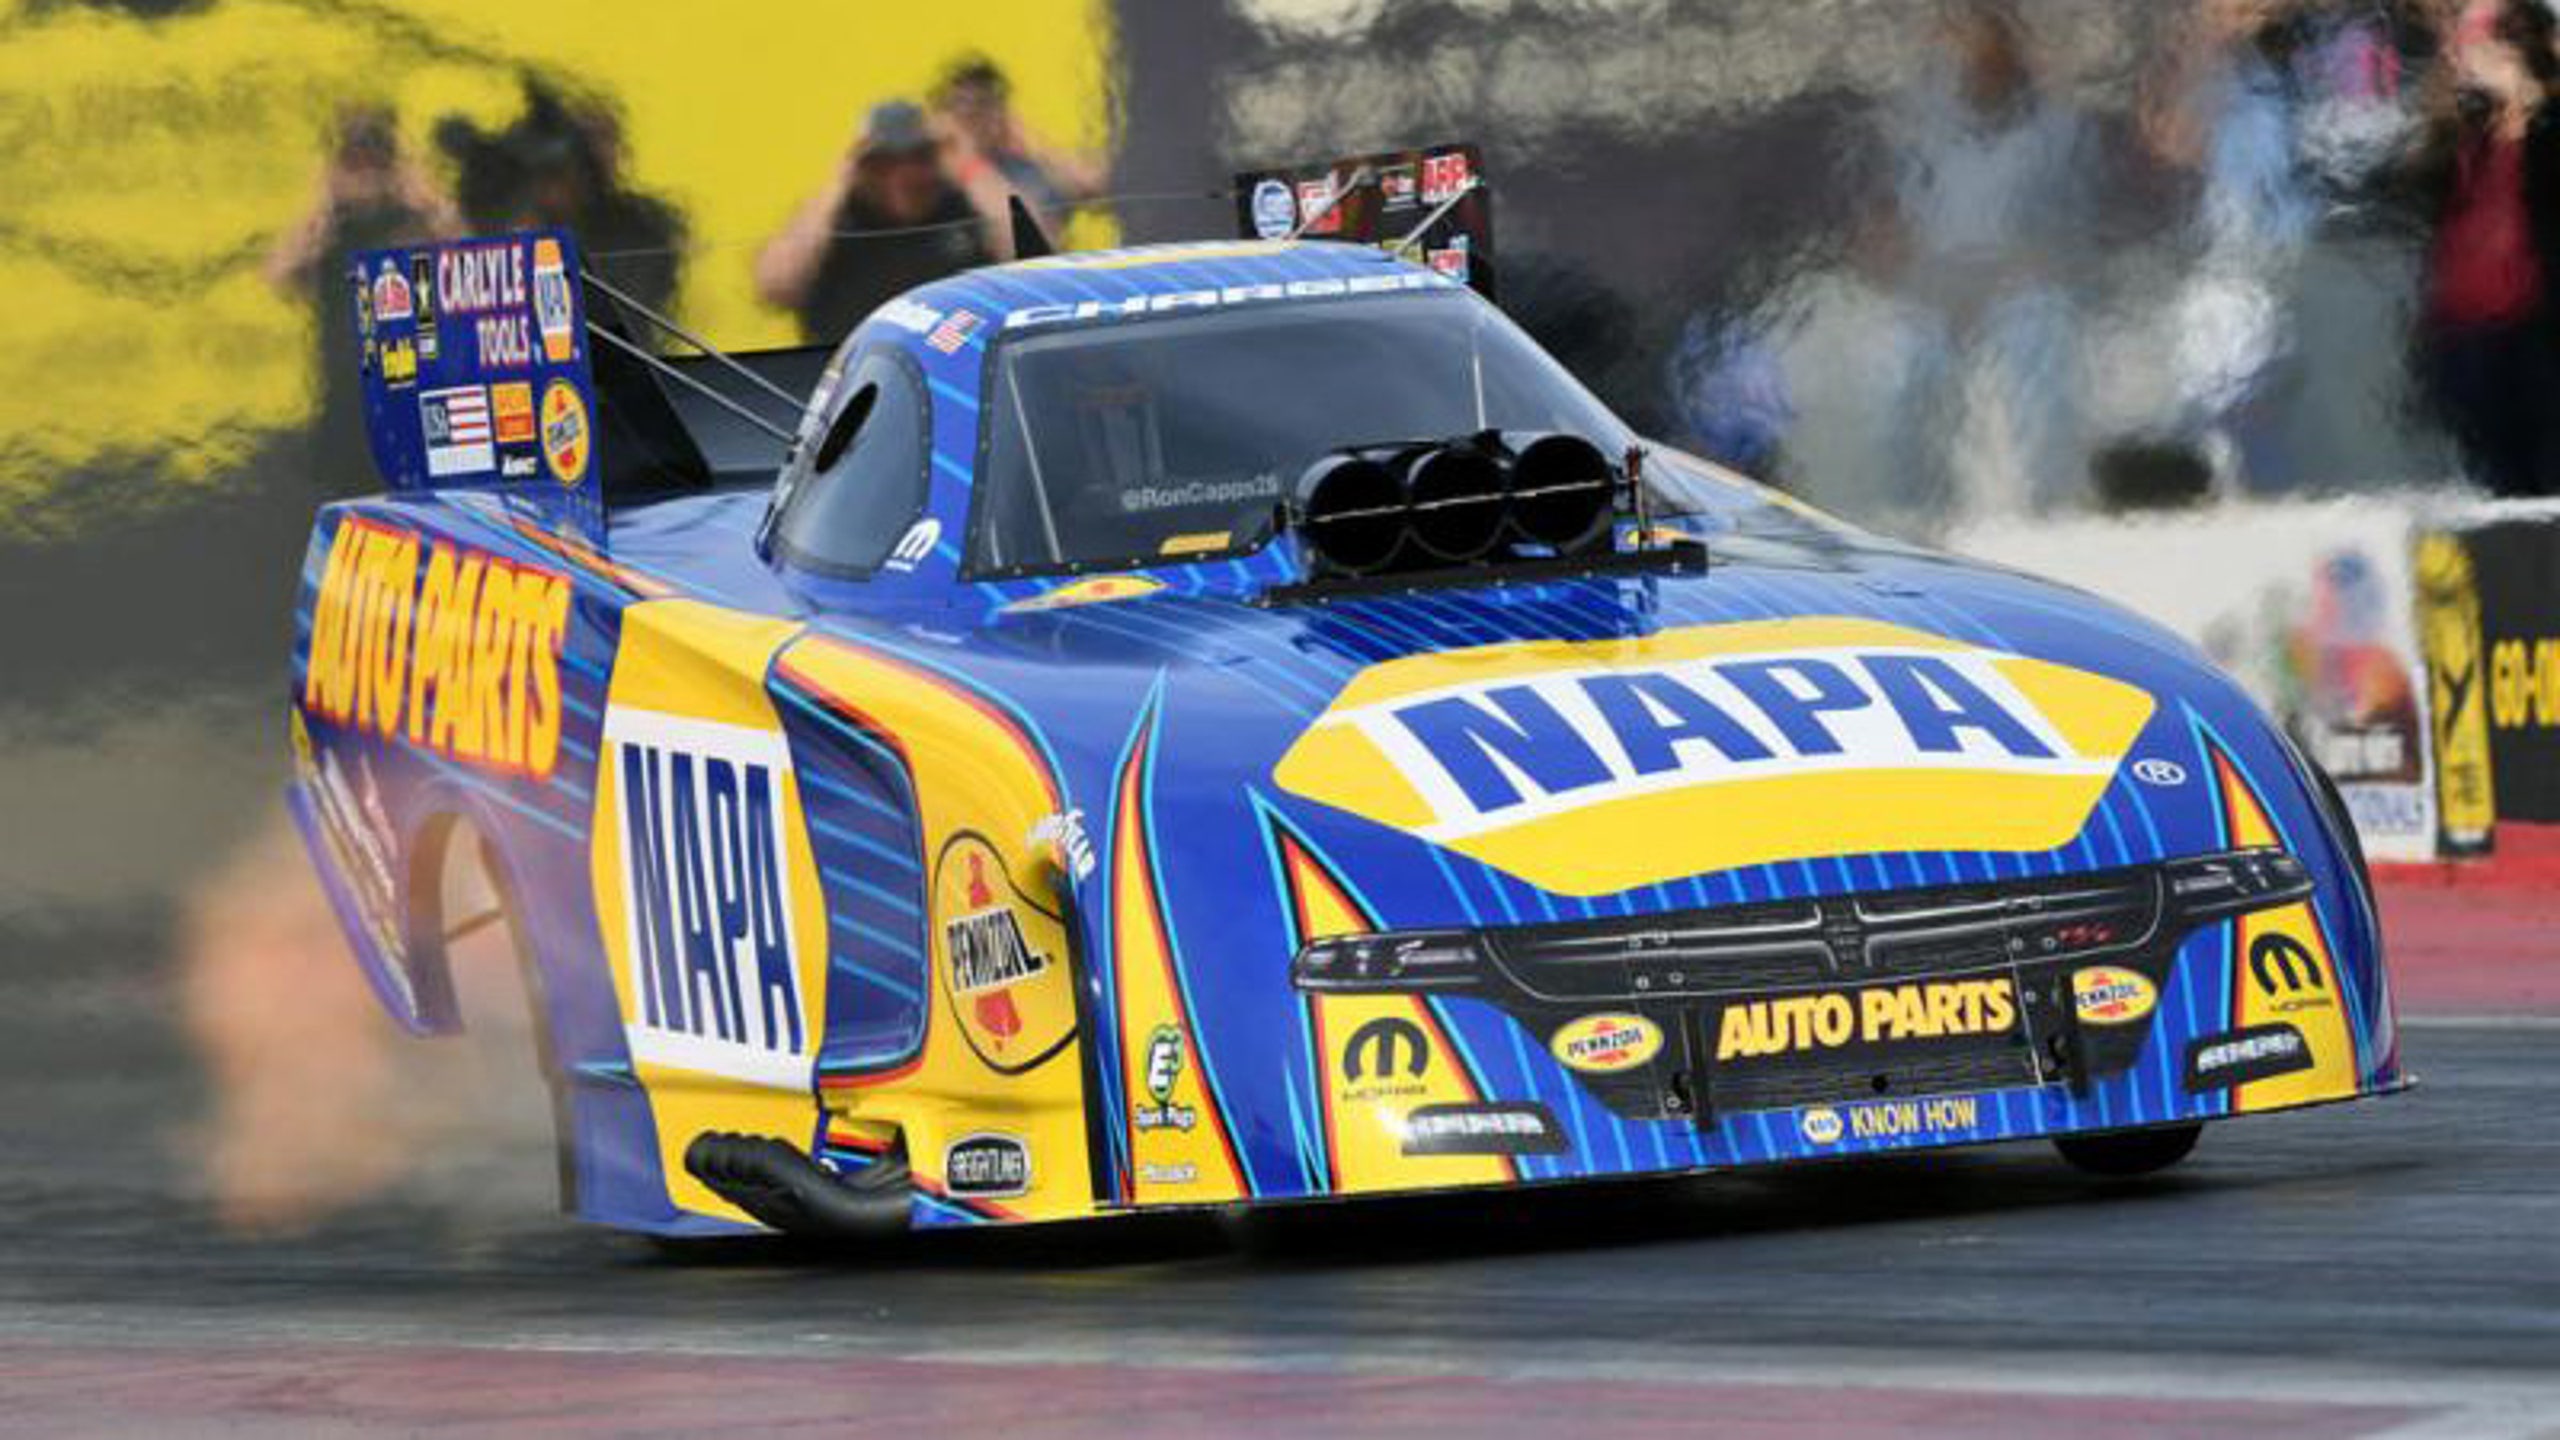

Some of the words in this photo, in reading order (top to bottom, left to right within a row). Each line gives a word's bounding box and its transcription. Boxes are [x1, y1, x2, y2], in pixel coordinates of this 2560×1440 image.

[438, 245, 527, 314] CARLYLE
[476, 315, 531, 368] TOOLS
[304, 513, 421, 742] AUTO
[408, 540, 573, 782] PARTS
[1392, 654, 2060, 813] NAPA
[621, 742, 802, 1056] NAPA
[1714, 996, 1856, 1062] AUTO
[1860, 977, 2016, 1043] PARTS
[2074, 980, 2142, 1012] ENNZOIL
[1849, 1102, 1919, 1139] KNOW
[1924, 1094, 1977, 1132] HOW
